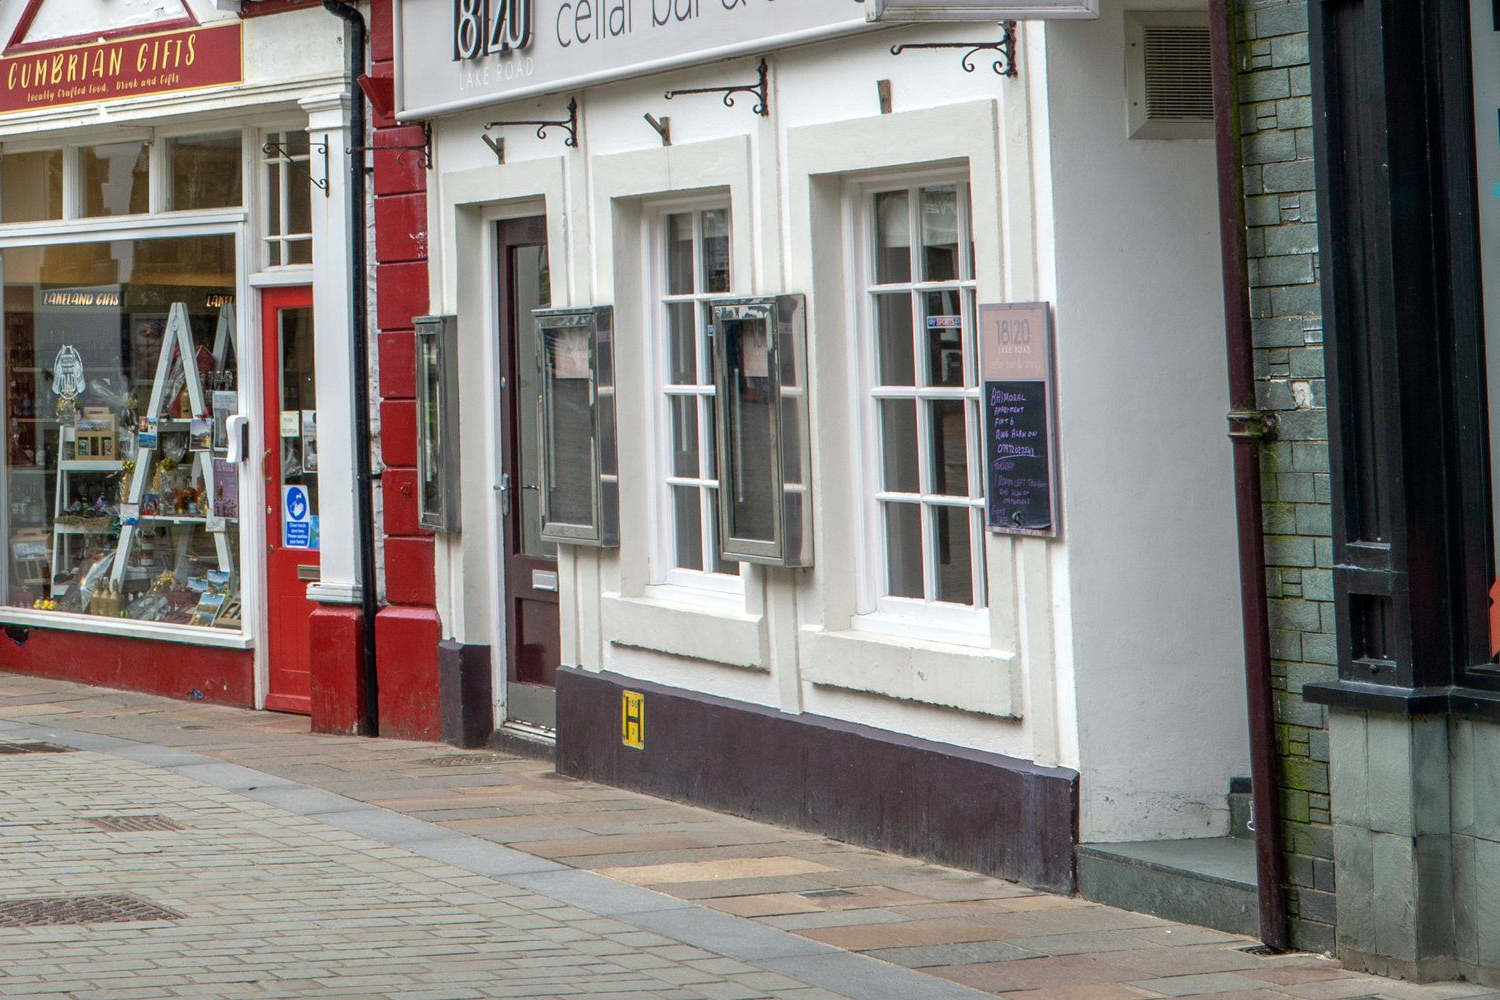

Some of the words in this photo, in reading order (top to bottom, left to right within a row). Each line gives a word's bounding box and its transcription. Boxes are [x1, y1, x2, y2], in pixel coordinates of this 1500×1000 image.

[7, 47, 123, 90] CUMBRIAN
[136, 33, 197, 73] GIFTS
[459, 66, 490, 91] LAKE
[497, 57, 534, 82] ROAD
[27, 88, 55, 102] Locally
[57, 85, 86, 99] Crafted
[116, 78, 138, 90] Drink
[141, 76, 157, 88] and
[159, 73, 180, 86] Gifts
[43, 292, 93, 307] LAKELAND
[95, 292, 119, 306] GIFTS
[936, 317, 955, 327] SPORTS
[625, 696, 641, 743] H
